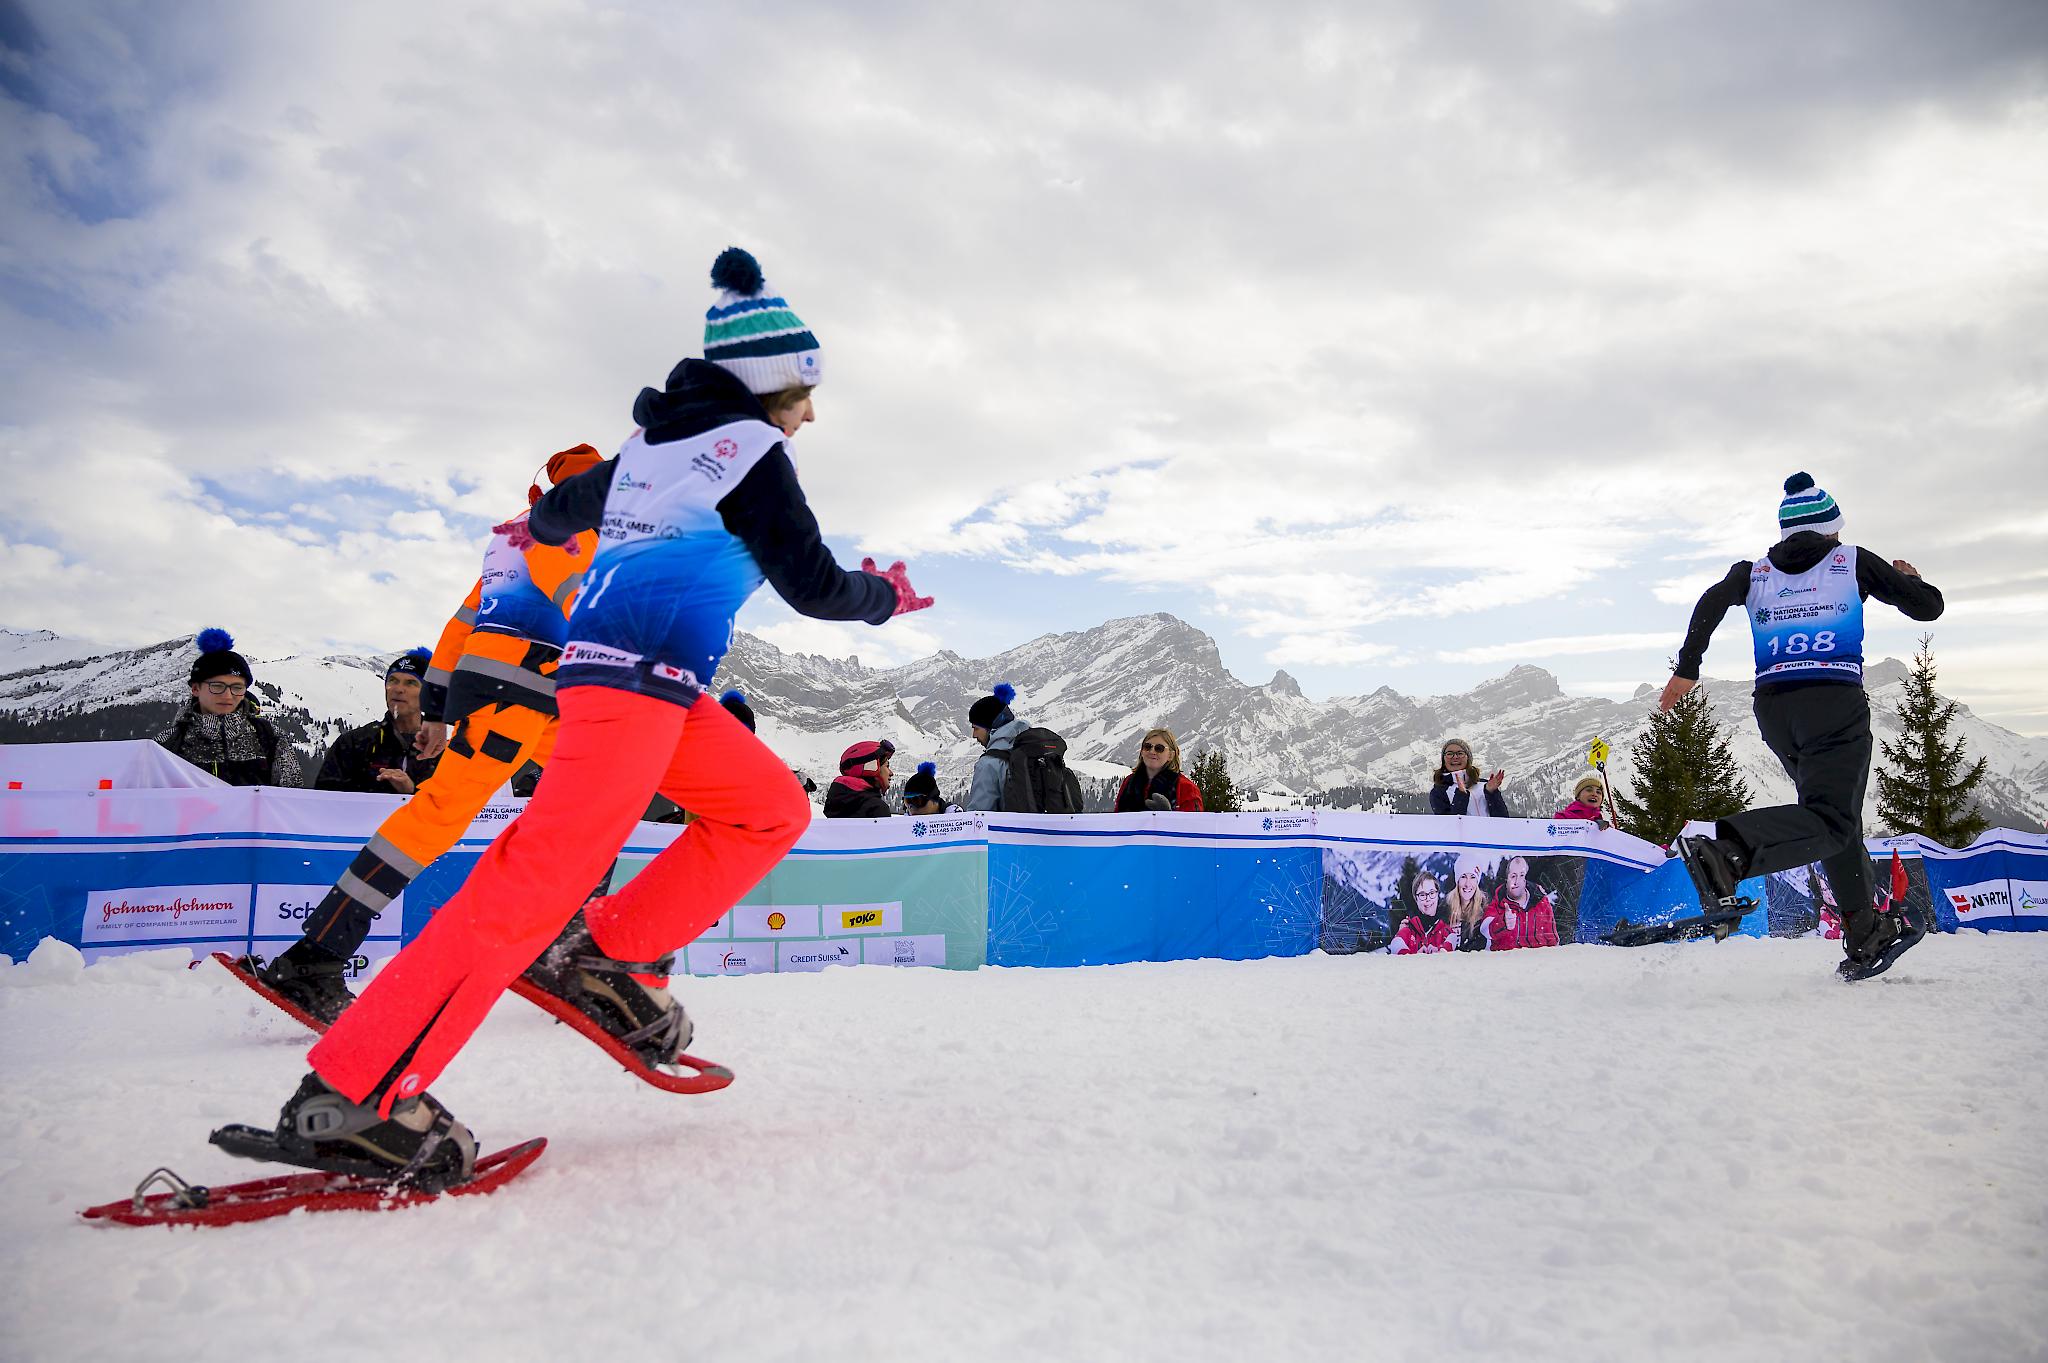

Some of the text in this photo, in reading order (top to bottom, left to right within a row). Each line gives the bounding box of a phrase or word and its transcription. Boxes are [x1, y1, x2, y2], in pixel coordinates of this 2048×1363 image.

[1773, 606, 1808, 616] NATIONAL
[1809, 604, 1834, 612] GAMES
[1773, 612, 1802, 621] VILLARS
[1767, 630, 1836, 657] 188
[929, 821, 955, 829] NATIONAL
[136, 920, 179, 928] COMPANIES
[189, 918, 238, 926] SWITZERLAND
[849, 911, 876, 927] TOKO
